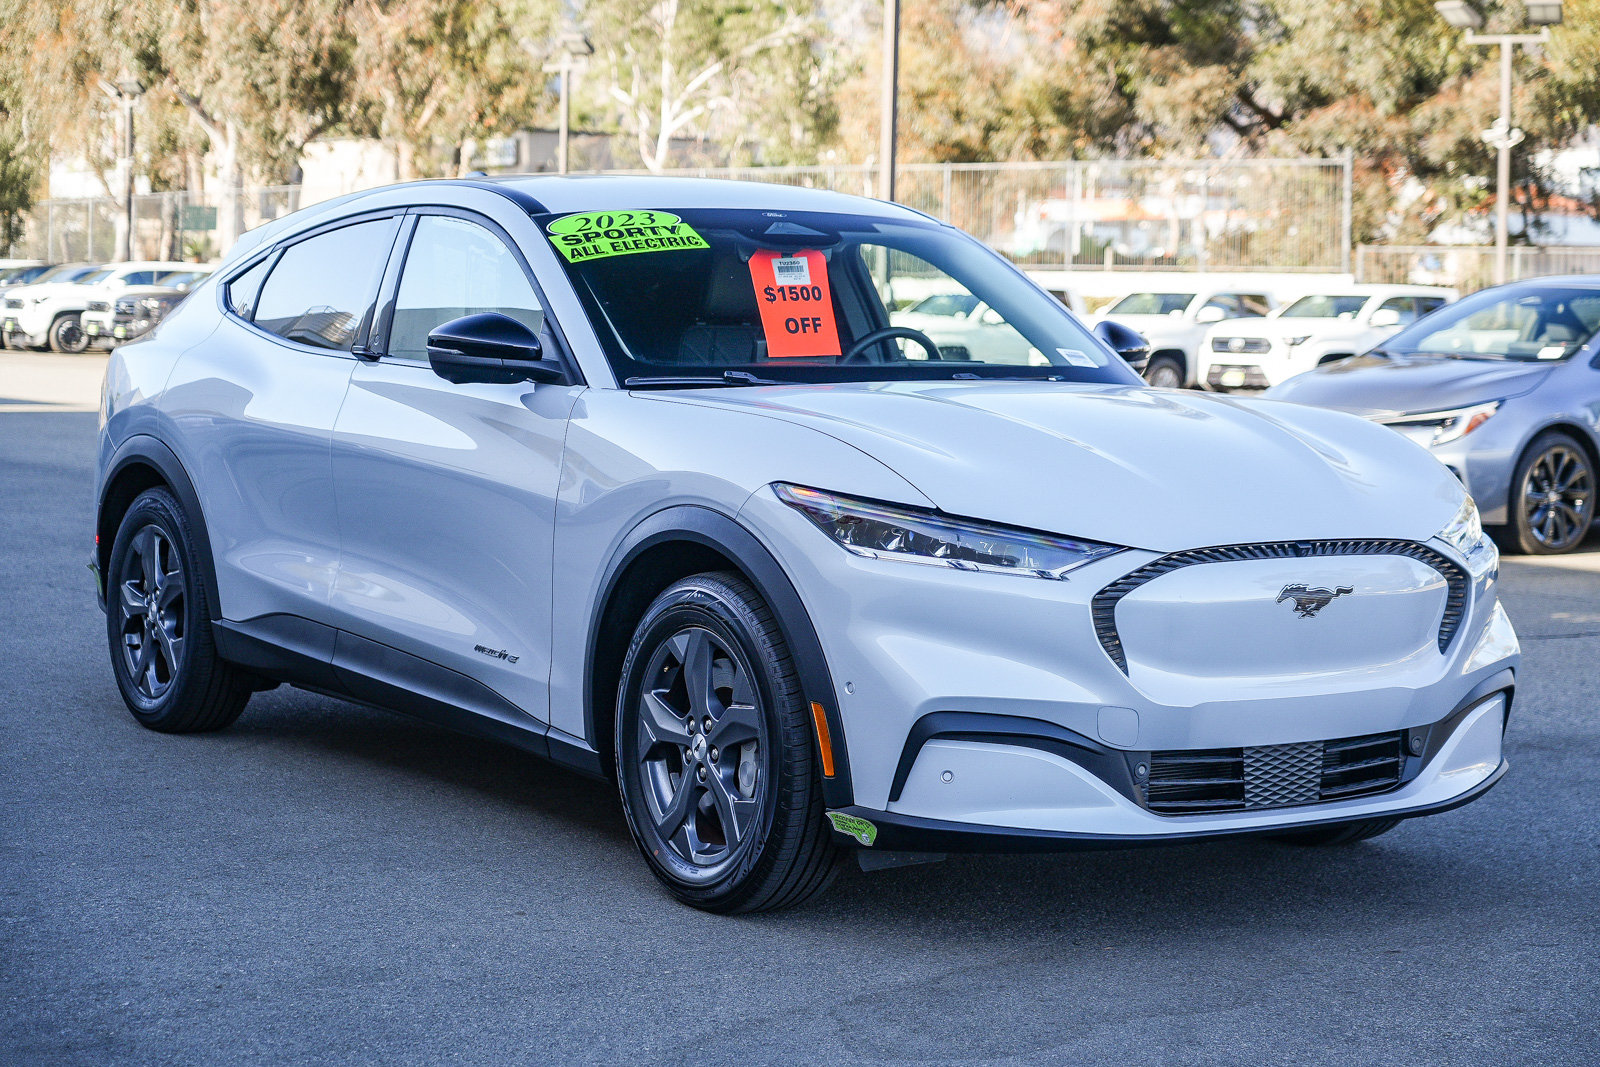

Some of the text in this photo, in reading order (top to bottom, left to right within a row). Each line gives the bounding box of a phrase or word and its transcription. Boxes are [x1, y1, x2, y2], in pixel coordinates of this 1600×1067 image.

[574, 212, 656, 232] 2023
[561, 225, 681, 246] SPORTY
[570, 235, 702, 260] ALL ELECTRIC
[763, 285, 822, 304] $1500
[785, 317, 822, 334] OFF
